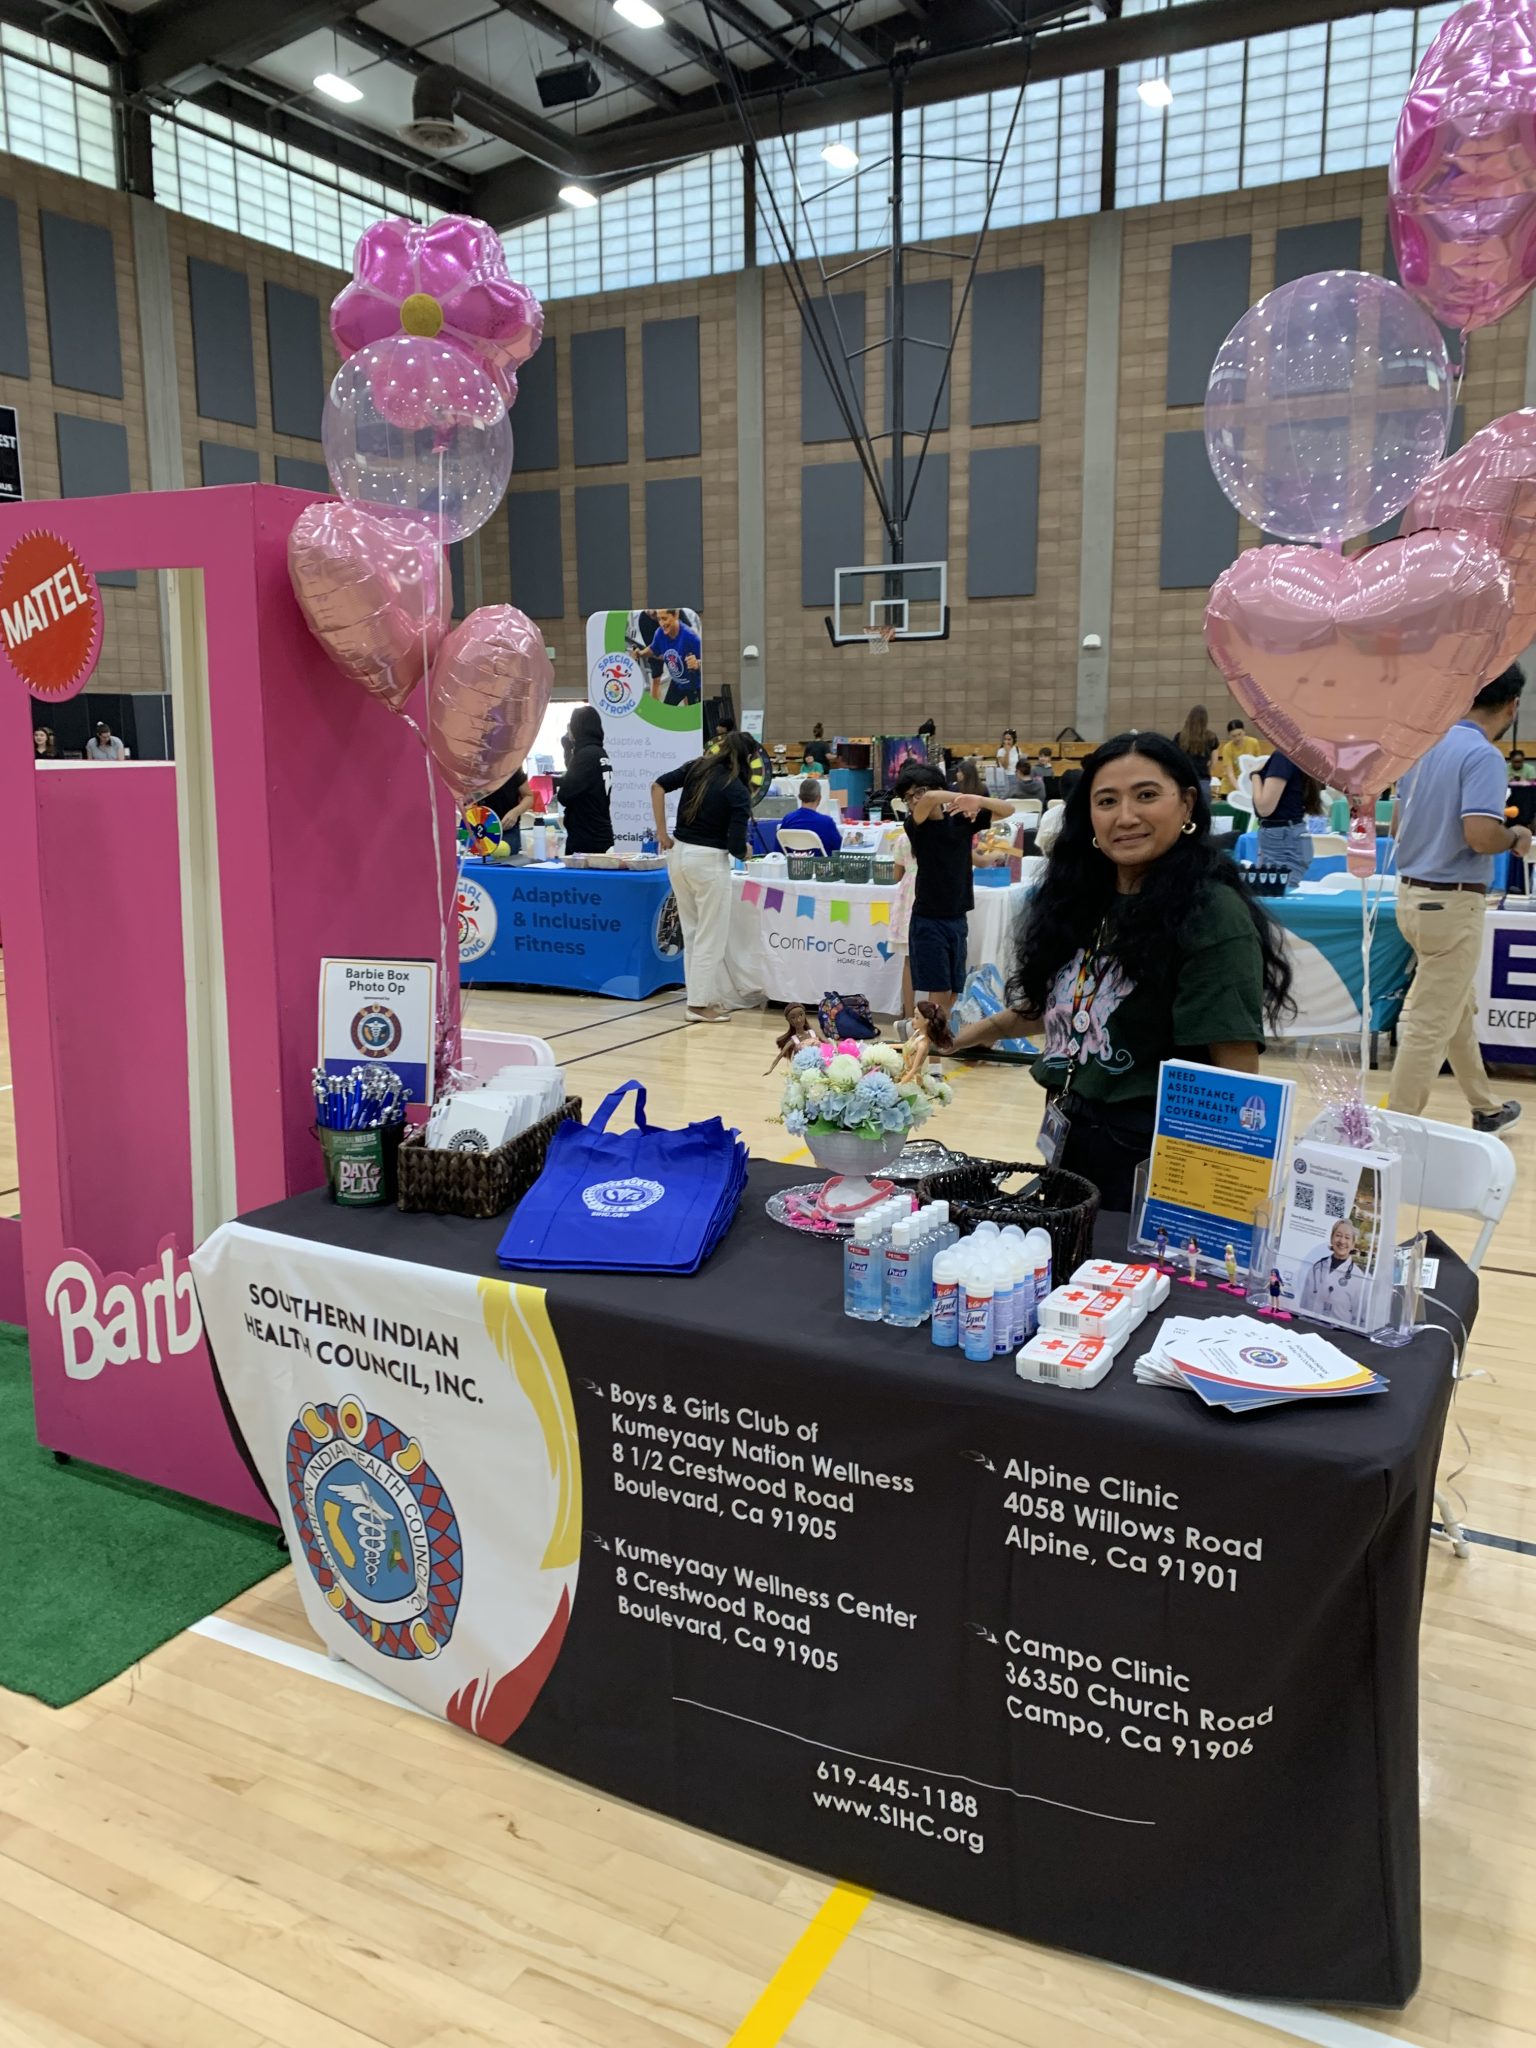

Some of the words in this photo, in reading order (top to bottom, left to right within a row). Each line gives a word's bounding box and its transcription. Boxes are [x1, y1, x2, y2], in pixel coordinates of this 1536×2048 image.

[1, 563, 88, 649] MATTEL
[599, 655, 634, 671] SPECIAL
[599, 699, 636, 714] STRONG
[608, 750, 642, 759] nclusive
[645, 750, 676, 759] Fitness
[613, 768, 637, 778] ental,
[612, 782, 646, 791] ognitive
[512, 886, 602, 907] Adaptive
[513, 914, 526, 927] &
[533, 912, 622, 932] Inclusive
[461, 939, 486, 957] ONG
[514, 936, 586, 955] Fitness
[769, 932, 873, 958] ComForCare
[837, 958, 856, 966] HOME
[857, 959, 871, 967] CARE
[346, 968, 384, 980] Barbie
[387, 970, 410, 981] Box
[349, 980, 385, 992] Photo
[388, 982, 405, 995] Op
[1168, 1070, 1196, 1082] NEED
[1167, 1082, 1235, 1101] ASSISTANCE
[1167, 1093, 1194, 1106] WITH
[1198, 1098, 1238, 1114] HEALTH
[1165, 1106, 1229, 1125] COVERAGE?
[340, 1161, 371, 1177] DAY
[340, 1176, 381, 1193] PLAY
[45, 1248, 203, 1380] Barb
[935, 1298, 955, 1312] Lysol
[249, 1283, 366, 1338] SOUTHERN
[374, 1317, 460, 1360] INDIAN
[966, 1310, 985, 1324] Lysol
[244, 1312, 312, 1359] HEALTH
[317, 1341, 430, 1395] COUNCIL,
[435, 1370, 484, 1404] INC.
[610, 1383, 657, 1412] Boys
[663, 1394, 677, 1415] &
[684, 1397, 731, 1425] Girls
[736, 1407, 790, 1437] Club
[797, 1422, 819, 1443] of
[612, 1413, 725, 1458] Kumeyaay
[732, 1436, 805, 1472] Nation
[811, 1454, 915, 1493] Wellness
[612, 1443, 625, 1462] 8
[630, 1445, 664, 1472] 1/2
[668, 1455, 787, 1499] Crestwood
[794, 1481, 855, 1513] Road
[1004, 1458, 1091, 1494] Alpine
[1100, 1477, 1180, 1511] Clinic
[614, 1472, 725, 1517] Boulevard,
[731, 1499, 763, 1525] Ca
[771, 1507, 837, 1540] 91905
[1003, 1491, 1065, 1523] 4058
[1073, 1504, 1176, 1545] Willows
[1185, 1526, 1263, 1561] Road
[1005, 1525, 1098, 1566] Alpine,
[1106, 1547, 1148, 1573] Ca
[1157, 1555, 1238, 1592] 91901
[615, 1536, 728, 1585] Kumeyaay
[734, 1566, 831, 1609] Wellness
[837, 1593, 918, 1630] Center
[616, 1566, 628, 1587] 8
[633, 1572, 747, 1618] Crestwood
[754, 1602, 811, 1635] Road
[618, 1595, 728, 1645] Boulevard,
[734, 1627, 767, 1653] Ca
[774, 1637, 839, 1672] 91905
[1004, 1630, 1103, 1673] Campo
[1111, 1657, 1191, 1693] Clinic
[1005, 1661, 1079, 1699] 36350
[1087, 1683, 1190, 1727] Church
[1200, 1705, 1274, 1732] Road
[1006, 1695, 1111, 1745] Campo,
[1120, 1725, 1162, 1753] Ca
[1171, 1735, 1254, 1760] 91906
[816, 1760, 978, 1818] 619-445-1188
[812, 1791, 985, 1854] www.SIHC.org
